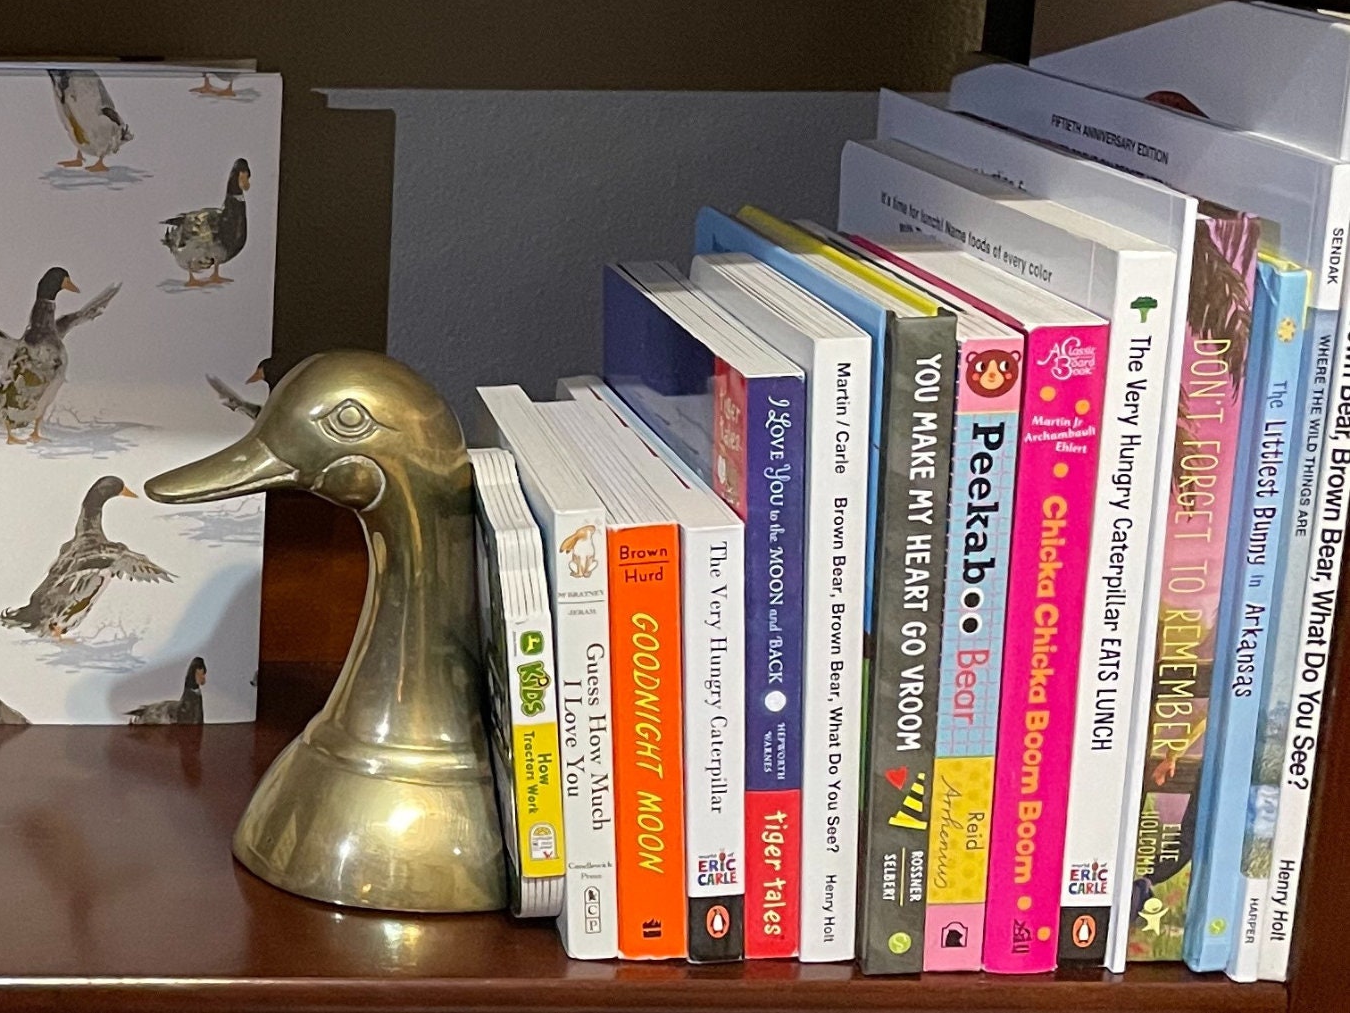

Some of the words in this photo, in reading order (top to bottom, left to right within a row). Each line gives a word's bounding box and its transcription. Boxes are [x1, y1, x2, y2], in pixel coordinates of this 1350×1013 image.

[1051, 114, 1081, 134] FIFTIETH
[1083, 125, 1136, 152] ANNIVERSARY
[1137, 142, 1169, 165] EDITION
[893, 195, 907, 215] time
[909, 204, 919, 220] for
[945, 220, 966, 243] Name
[968, 231, 991, 254] foods
[993, 245, 1002, 259] of
[1003, 251, 1027, 275] every
[1029, 261, 1052, 283] color
[1327, 228, 1344, 284] SENDAK
[914, 353, 942, 402] YOU
[1128, 335, 1152, 372] The
[1314, 334, 1331, 384] WHERE
[768, 396, 790, 407] I
[836, 362, 851, 416] Martin
[1117, 379, 1147, 427] Very
[1186, 339, 1231, 423] DON'T
[1267, 380, 1288, 409] The
[1310, 388, 1325, 414] THE
[909, 411, 938, 480] MAKE
[1024, 426, 1096, 443] Archambault
[1032, 416, 1071, 427] Martin
[1073, 417, 1084, 429] Jr
[1306, 418, 1320, 453] WILD
[834, 430, 850, 475] Carle
[1055, 441, 1088, 454] Ehlert
[1256, 421, 1287, 498] Littlest
[1109, 434, 1142, 510] Hungry
[1174, 441, 1221, 542] FORGET
[1300, 457, 1316, 505] THINGS
[1323, 448, 1350, 521] Brown
[770, 510, 780, 521] to
[833, 497, 848, 550] Brown
[907, 489, 934, 525] MY
[1295, 510, 1309, 537] ARE
[620, 545, 668, 560] Brown
[770, 524, 785, 542] the
[1036, 495, 1067, 597] Chicka
[1247, 507, 1276, 565] Bunny
[1311, 529, 1342, 582] Bear,
[625, 566, 664, 583] Hurd
[710, 541, 727, 577] The
[769, 546, 783, 605] MOON
[829, 555, 846, 598] Bear,
[903, 534, 932, 612] HEART
[1102, 517, 1133, 639] Caterpillar
[1168, 559, 1208, 593] TO
[704, 585, 727, 629] Very
[770, 608, 782, 632] and
[831, 603, 845, 655] Brown
[1308, 589, 1335, 645] What
[768, 636, 783, 684] BACK
[900, 621, 927, 656] GO
[1029, 603, 1059, 705] Chicka
[1097, 638, 1122, 682] EATS
[1232, 603, 1265, 697] Arkansas
[563, 679, 582, 687] I
[586, 643, 605, 706] Guess
[704, 637, 727, 709] Hungry
[827, 661, 844, 701] Bear,
[953, 650, 991, 725] Bear
[1151, 609, 1202, 757] REMEMBER
[1302, 654, 1326, 683] Do
[631, 612, 663, 779] GOODNIGHT
[896, 664, 925, 751] VROOM
[1296, 690, 1321, 729] You
[564, 697, 583, 748] Love
[589, 715, 607, 765] How
[829, 707, 843, 750] What
[1091, 689, 1117, 751] LUNCH
[524, 731, 535, 780] Tractors
[538, 753, 552, 785] How
[704, 716, 727, 814] Caterpillar
[763, 731, 773, 773] WARNES
[777, 722, 786, 780] HEPWORTH
[828, 753, 841, 775] Do
[1020, 711, 1050, 794] Boom
[1288, 735, 1315, 791] See?
[527, 784, 539, 814] Work
[566, 755, 585, 797] You
[827, 781, 841, 812] You
[591, 772, 612, 830] Much
[636, 791, 665, 874] MOON
[761, 810, 788, 871] tiger
[827, 815, 841, 853] See?
[966, 812, 985, 851] Reid
[1014, 801, 1043, 885] Boom
[1136, 811, 1160, 877] HOLCOMB
[1159, 823, 1182, 863] ELLIE
[698, 871, 737, 886] CARLE
[822, 875, 838, 917] Henry
[882, 853, 897, 901] SELBERT
[909, 851, 924, 903] ROSSNER
[1068, 882, 1108, 895] CARLE
[1272, 859, 1296, 907] Henry
[763, 878, 787, 936] tales
[823, 919, 835, 943] Holt
[1244, 898, 1260, 944] HARPER
[1270, 910, 1289, 941] Holt
